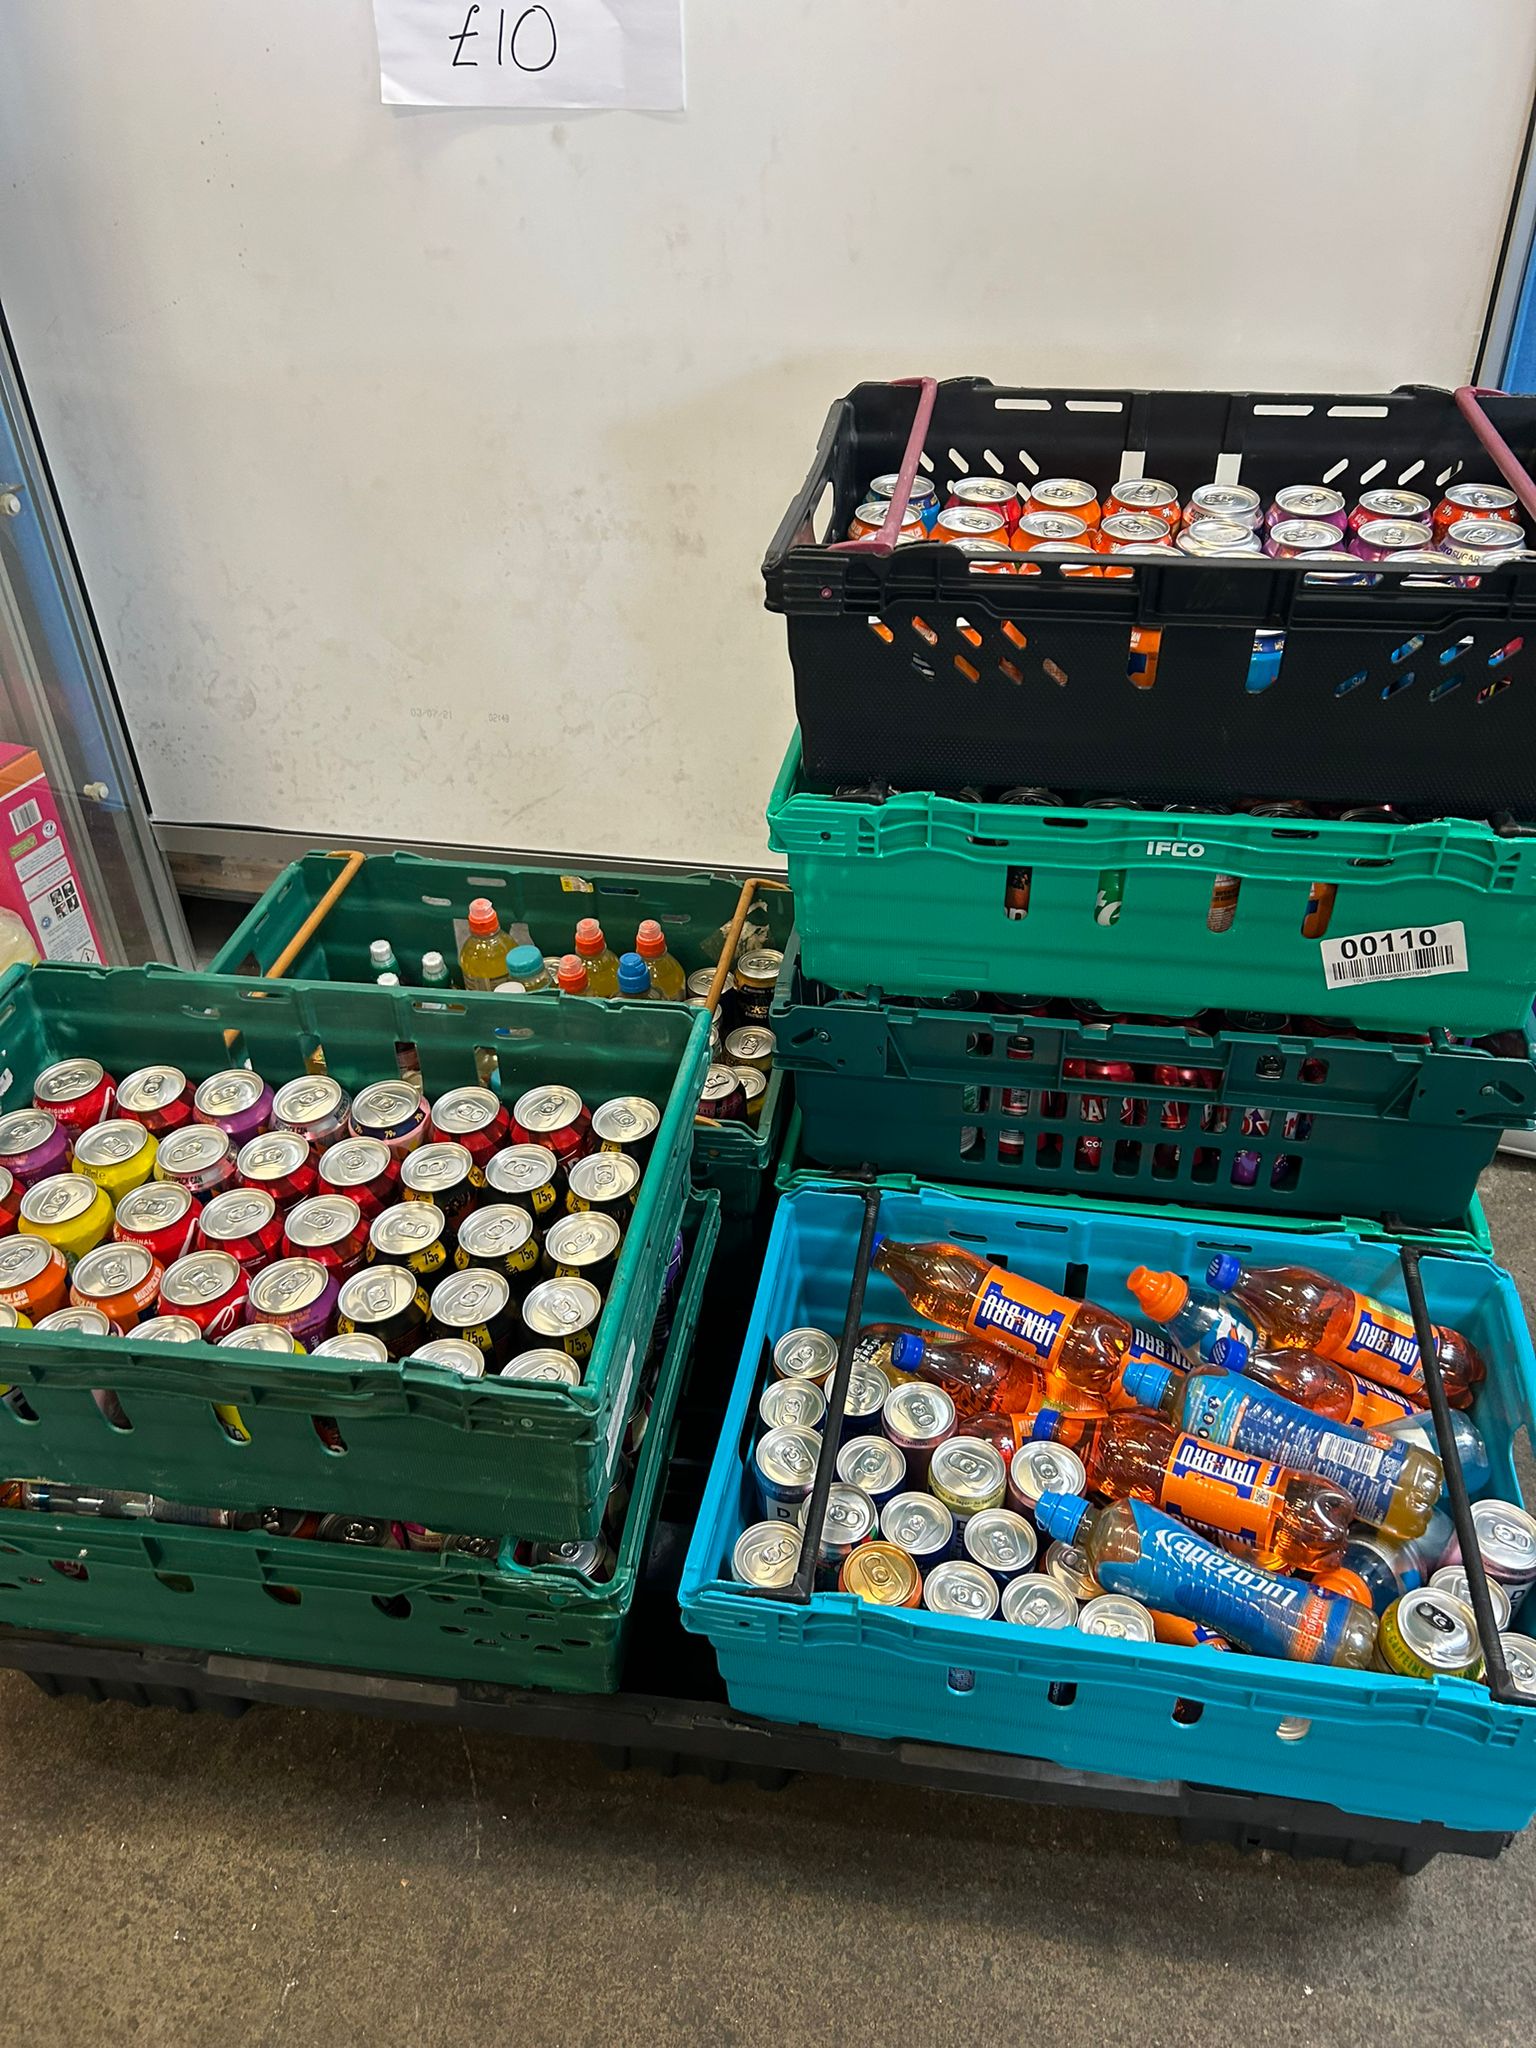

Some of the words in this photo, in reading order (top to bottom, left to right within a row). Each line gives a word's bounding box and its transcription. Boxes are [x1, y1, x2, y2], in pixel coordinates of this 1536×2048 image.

[449, 4, 557, 72] £10
[1146, 840, 1206, 858] IFCO
[1341, 929, 1437, 960] 00110
[536, 1192, 552, 1204] 75p
[422, 1250, 441, 1266] 75p
[518, 1248, 535, 1263] 75p
[13, 1289, 29, 1301] CAN
[466, 1331, 484, 1347] 75p
[569, 1337, 588, 1350] 75p
[1388, 1636, 1427, 1678] CAFFEINE
